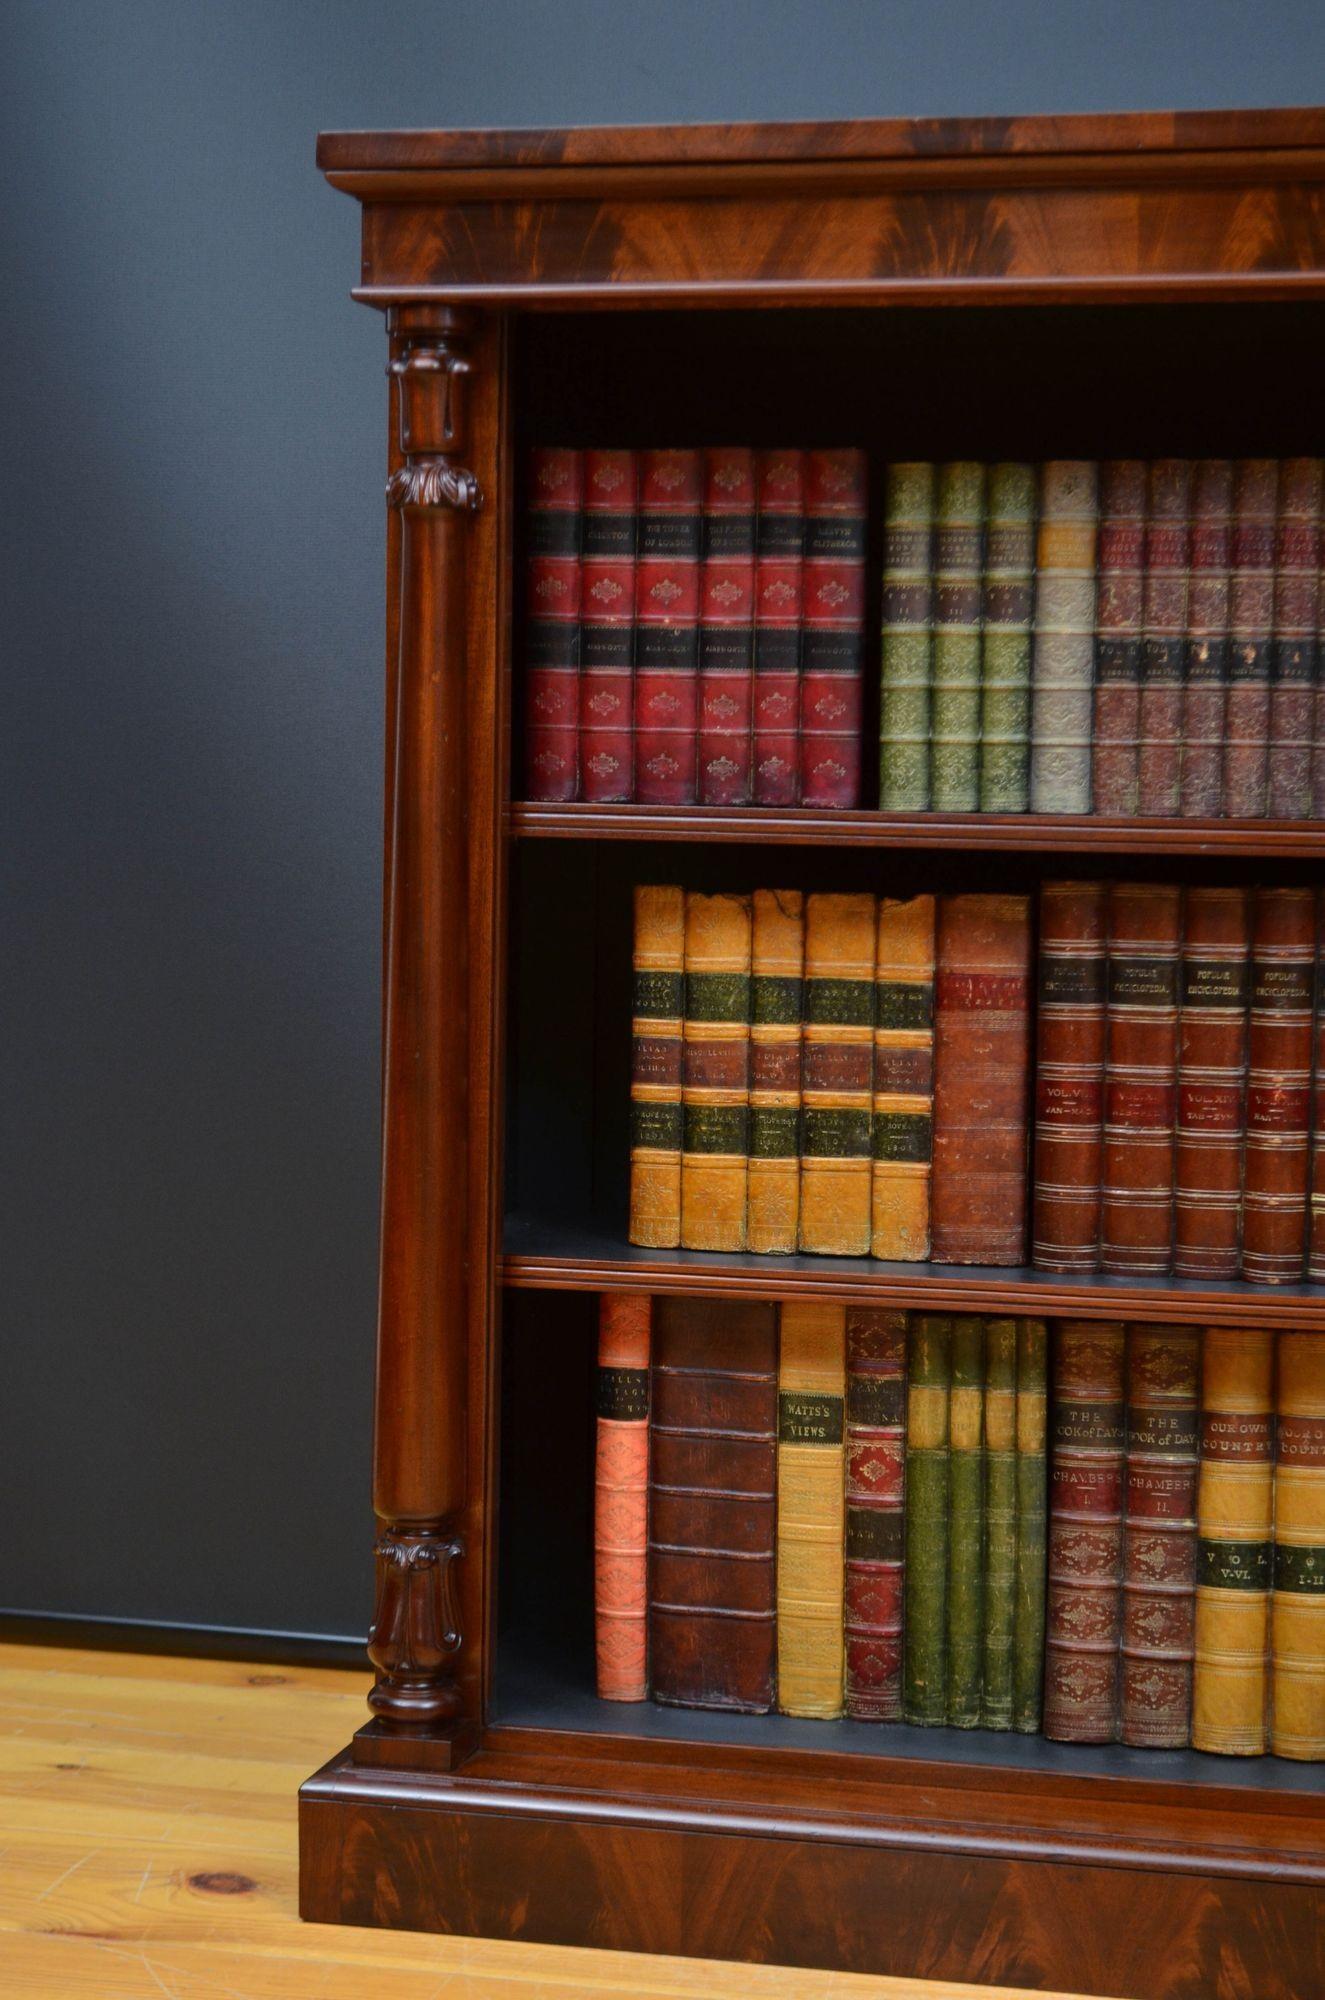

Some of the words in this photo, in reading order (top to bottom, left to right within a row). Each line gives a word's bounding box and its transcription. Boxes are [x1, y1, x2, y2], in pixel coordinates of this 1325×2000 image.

[1196, 970, 1232, 981] POPULAR
[1263, 972, 1299, 982] POPULAR
[786, 1403, 831, 1418] WATTS'S
[1069, 1411, 1102, 1423] THE
[1146, 1416, 1180, 1429] THE
[1056, 1426, 1080, 1438] OOK
[1080, 1427, 1096, 1439] of
[1210, 1422, 1236, 1434] OUR
[1239, 1423, 1268, 1434] OWN
[1157, 1433, 1173, 1446] of
[1174, 1433, 1196, 1445] DAY
